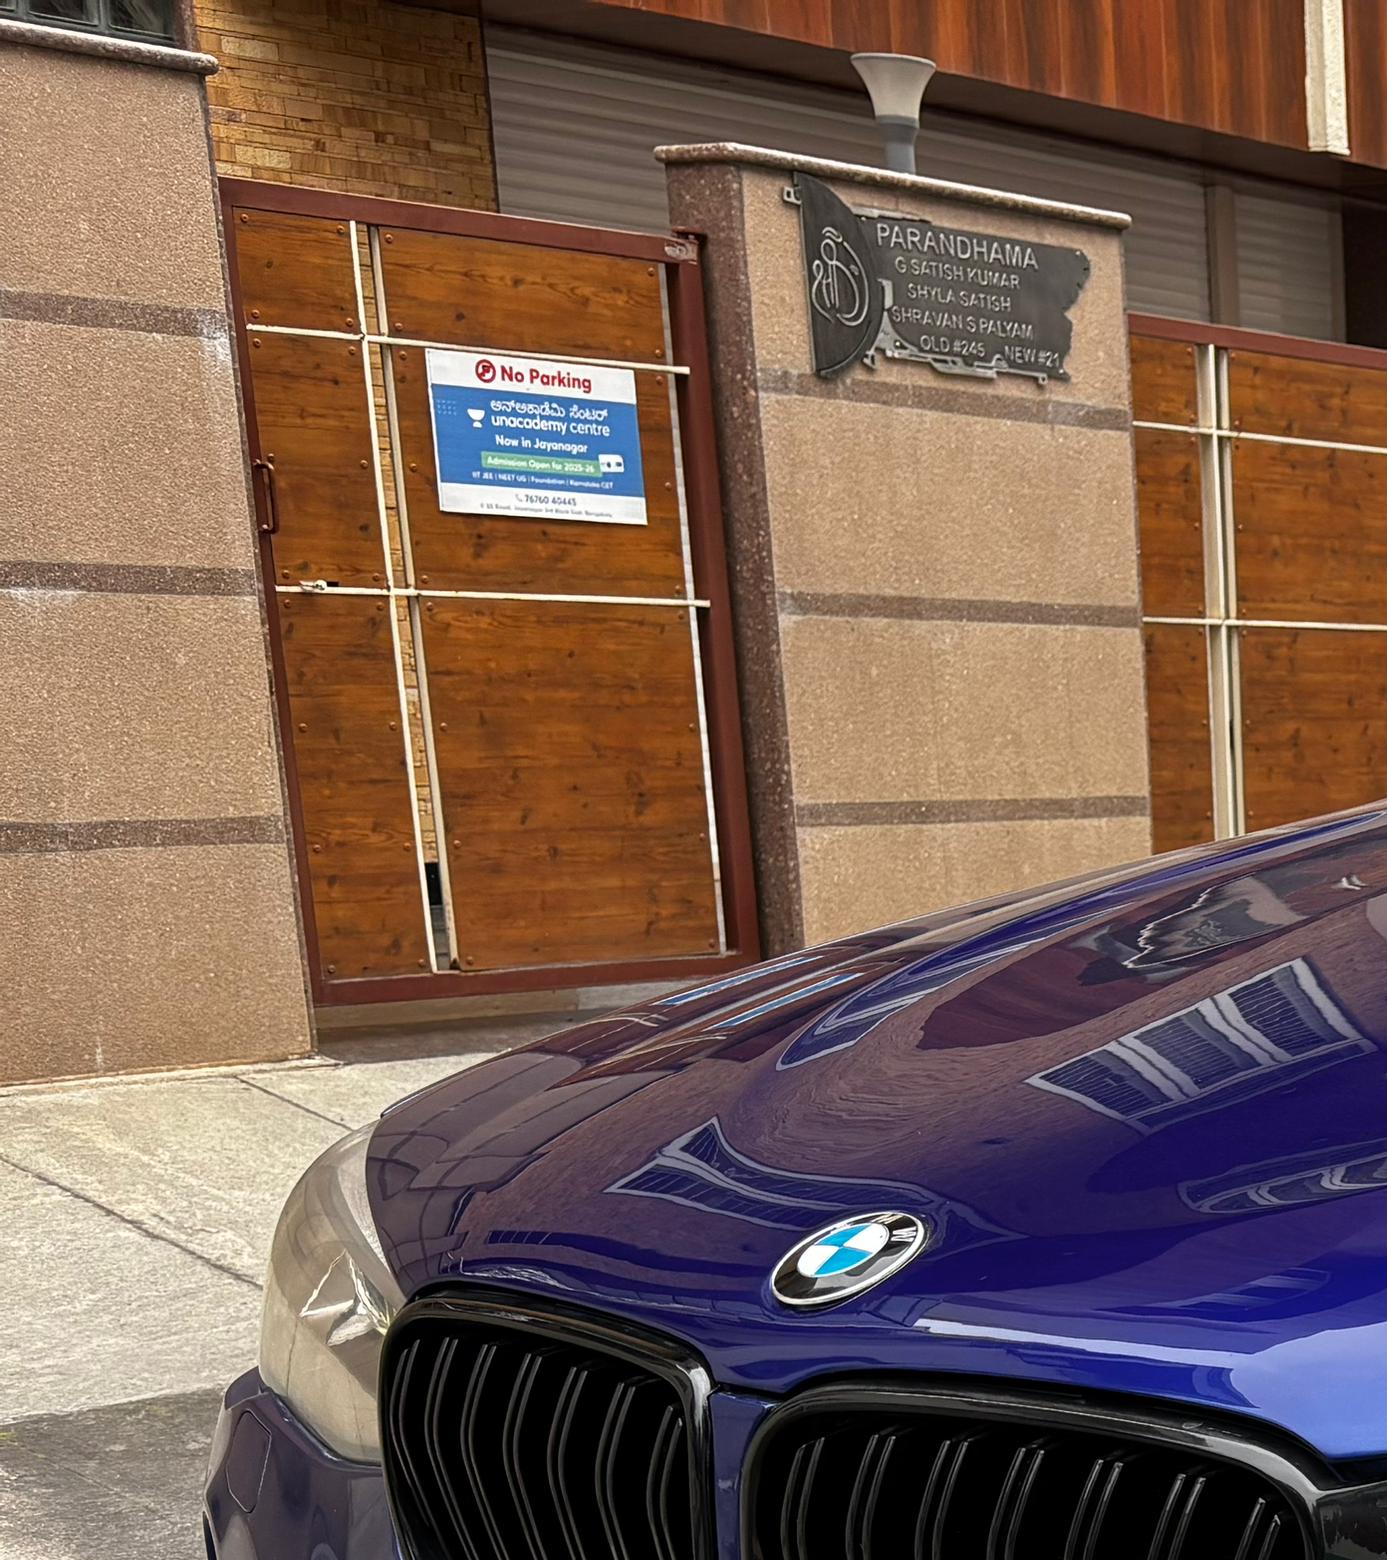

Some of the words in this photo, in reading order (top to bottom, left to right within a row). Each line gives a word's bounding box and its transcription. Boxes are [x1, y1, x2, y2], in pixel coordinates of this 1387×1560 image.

[877, 223, 1039, 270] PARANDHAMA
[895, 257, 907, 274] G
[911, 260, 965, 281] SATISH
[967, 268, 1021, 290] KUMAR
[907, 283, 956, 303] SHYLA
[959, 291, 1012, 312] SATISH
[891, 306, 964, 330] SHRAVAN
[966, 317, 977, 334] S
[980, 317, 1035, 340] PALYAM
[920, 335, 950, 353] OLD
[1004, 345, 1035, 364] NEW
[501, 365, 525, 383] No
[530, 368, 592, 394] Parking
[491, 414, 567, 436] unacademy
[570, 422, 610, 437] centre
[496, 434, 519, 447] Now
[521, 435, 531, 448] in
[533, 438, 588, 456] Jayanagar
